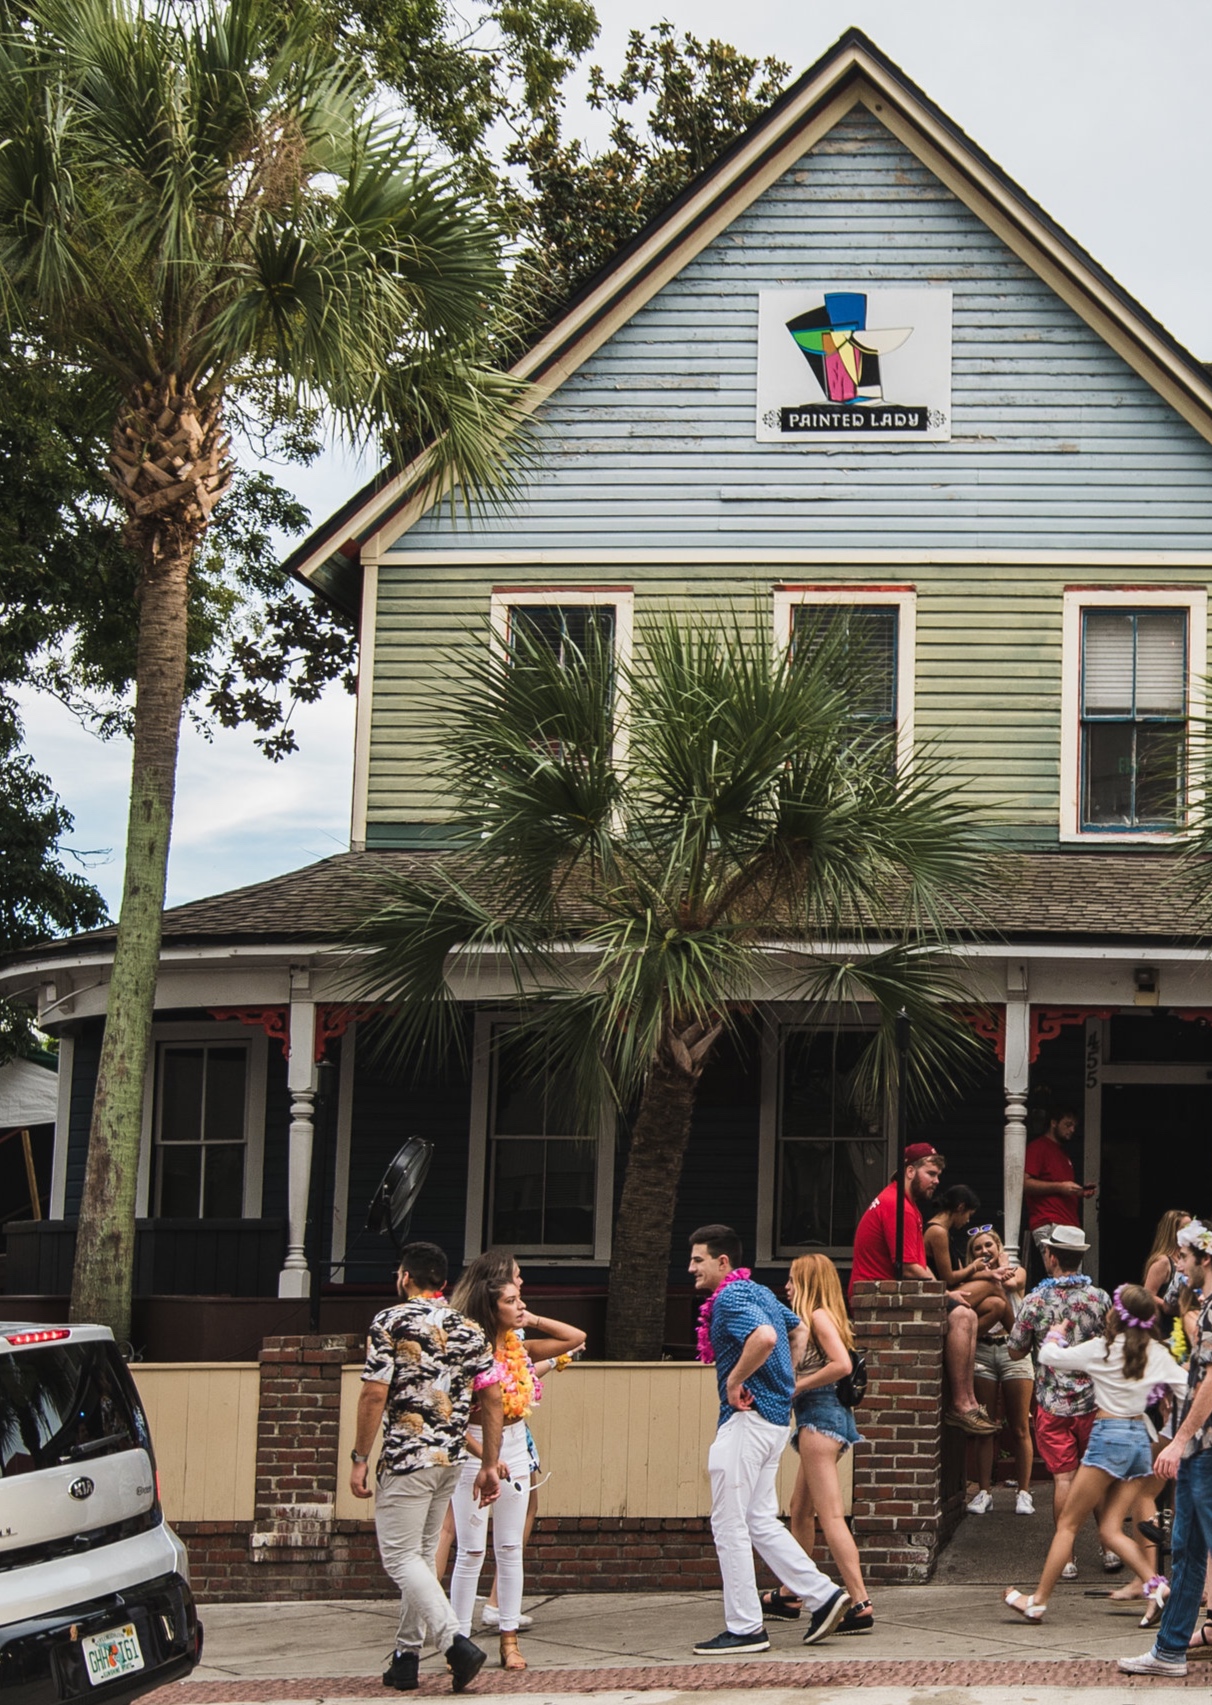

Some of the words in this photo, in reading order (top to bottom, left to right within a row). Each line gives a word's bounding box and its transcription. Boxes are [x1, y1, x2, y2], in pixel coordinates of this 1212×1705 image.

[789, 413, 864, 427] PAINTED
[871, 413, 918, 427] LADY
[1087, 1030, 1099, 1089] 455
[74, 1482, 93, 1496] KIA
